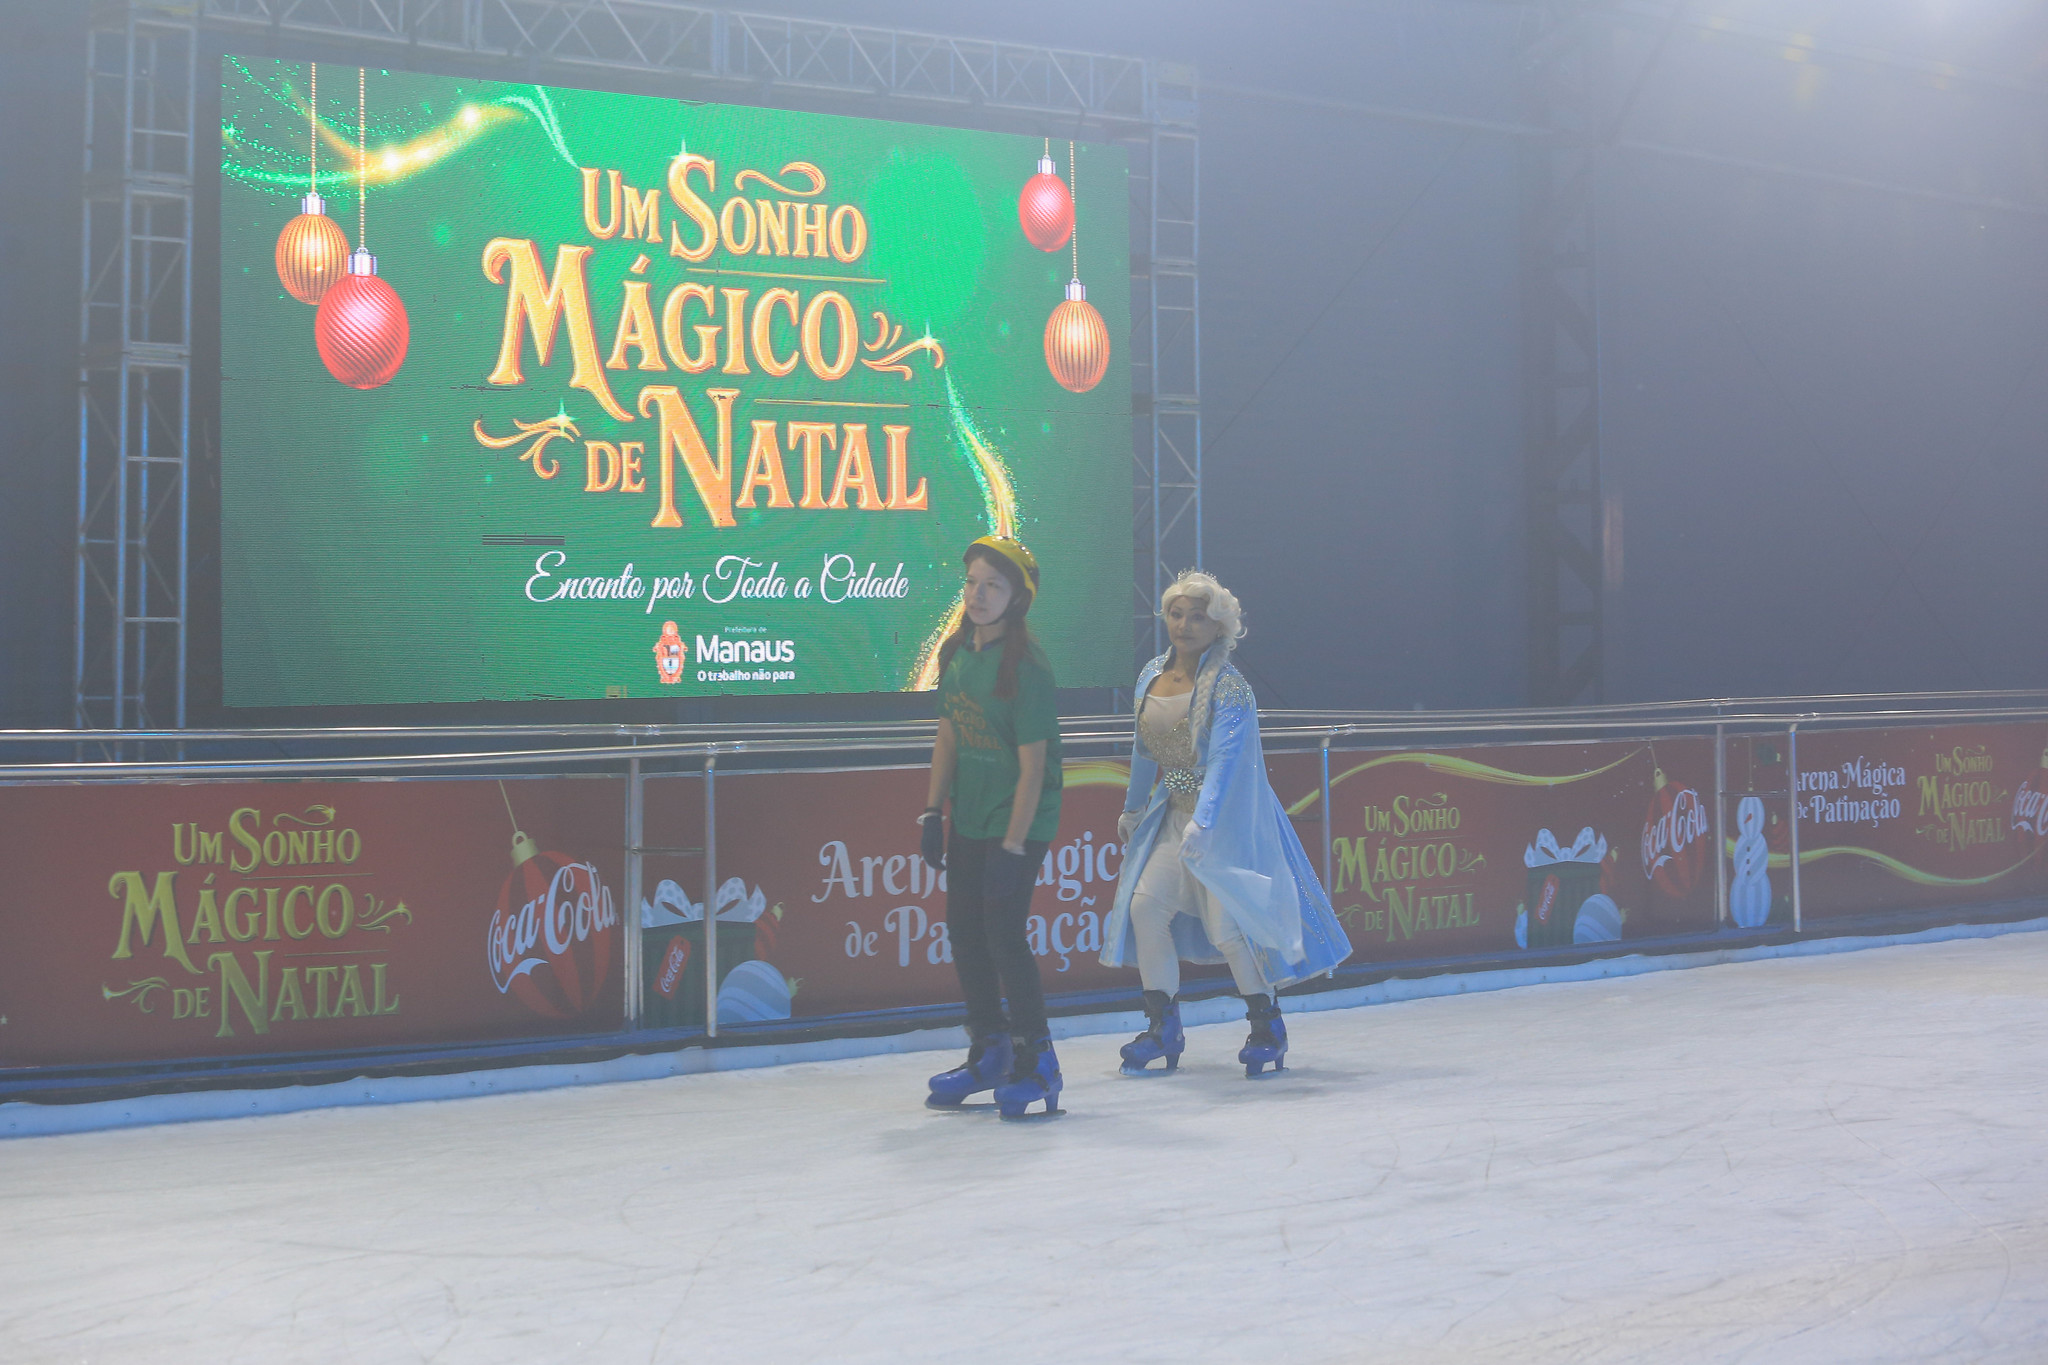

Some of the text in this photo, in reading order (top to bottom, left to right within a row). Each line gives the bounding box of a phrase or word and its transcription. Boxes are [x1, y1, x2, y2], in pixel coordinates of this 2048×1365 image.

[580, 154, 867, 263] UM SONHO
[482, 237, 858, 421] MÁGICO
[584, 385, 928, 527] DE NATAL
[525, 551, 909, 614] Encanto por Toda a Cidade
[696, 634, 795, 663] Manaus
[697, 670, 707, 681] O
[752, 668, 771, 680] não
[772, 671, 795, 683] para
[1842, 755, 1906, 795] Mágica
[172, 807, 362, 873] UM SONHO
[1364, 795, 1460, 837] UM SONHO
[1641, 788, 1708, 880] Coca-Cola
[1810, 793, 1901, 828] Patinação
[1332, 837, 1457, 902] MÁGICO
[109, 870, 354, 974] MÁGICO
[488, 861, 617, 994] Coca-Cola
[845, 921, 878, 957] de
[1364, 886, 1480, 943] DE NATAL
[172, 950, 400, 1037] DE NATAL
[661, 945, 684, 993] Coca-Cola
